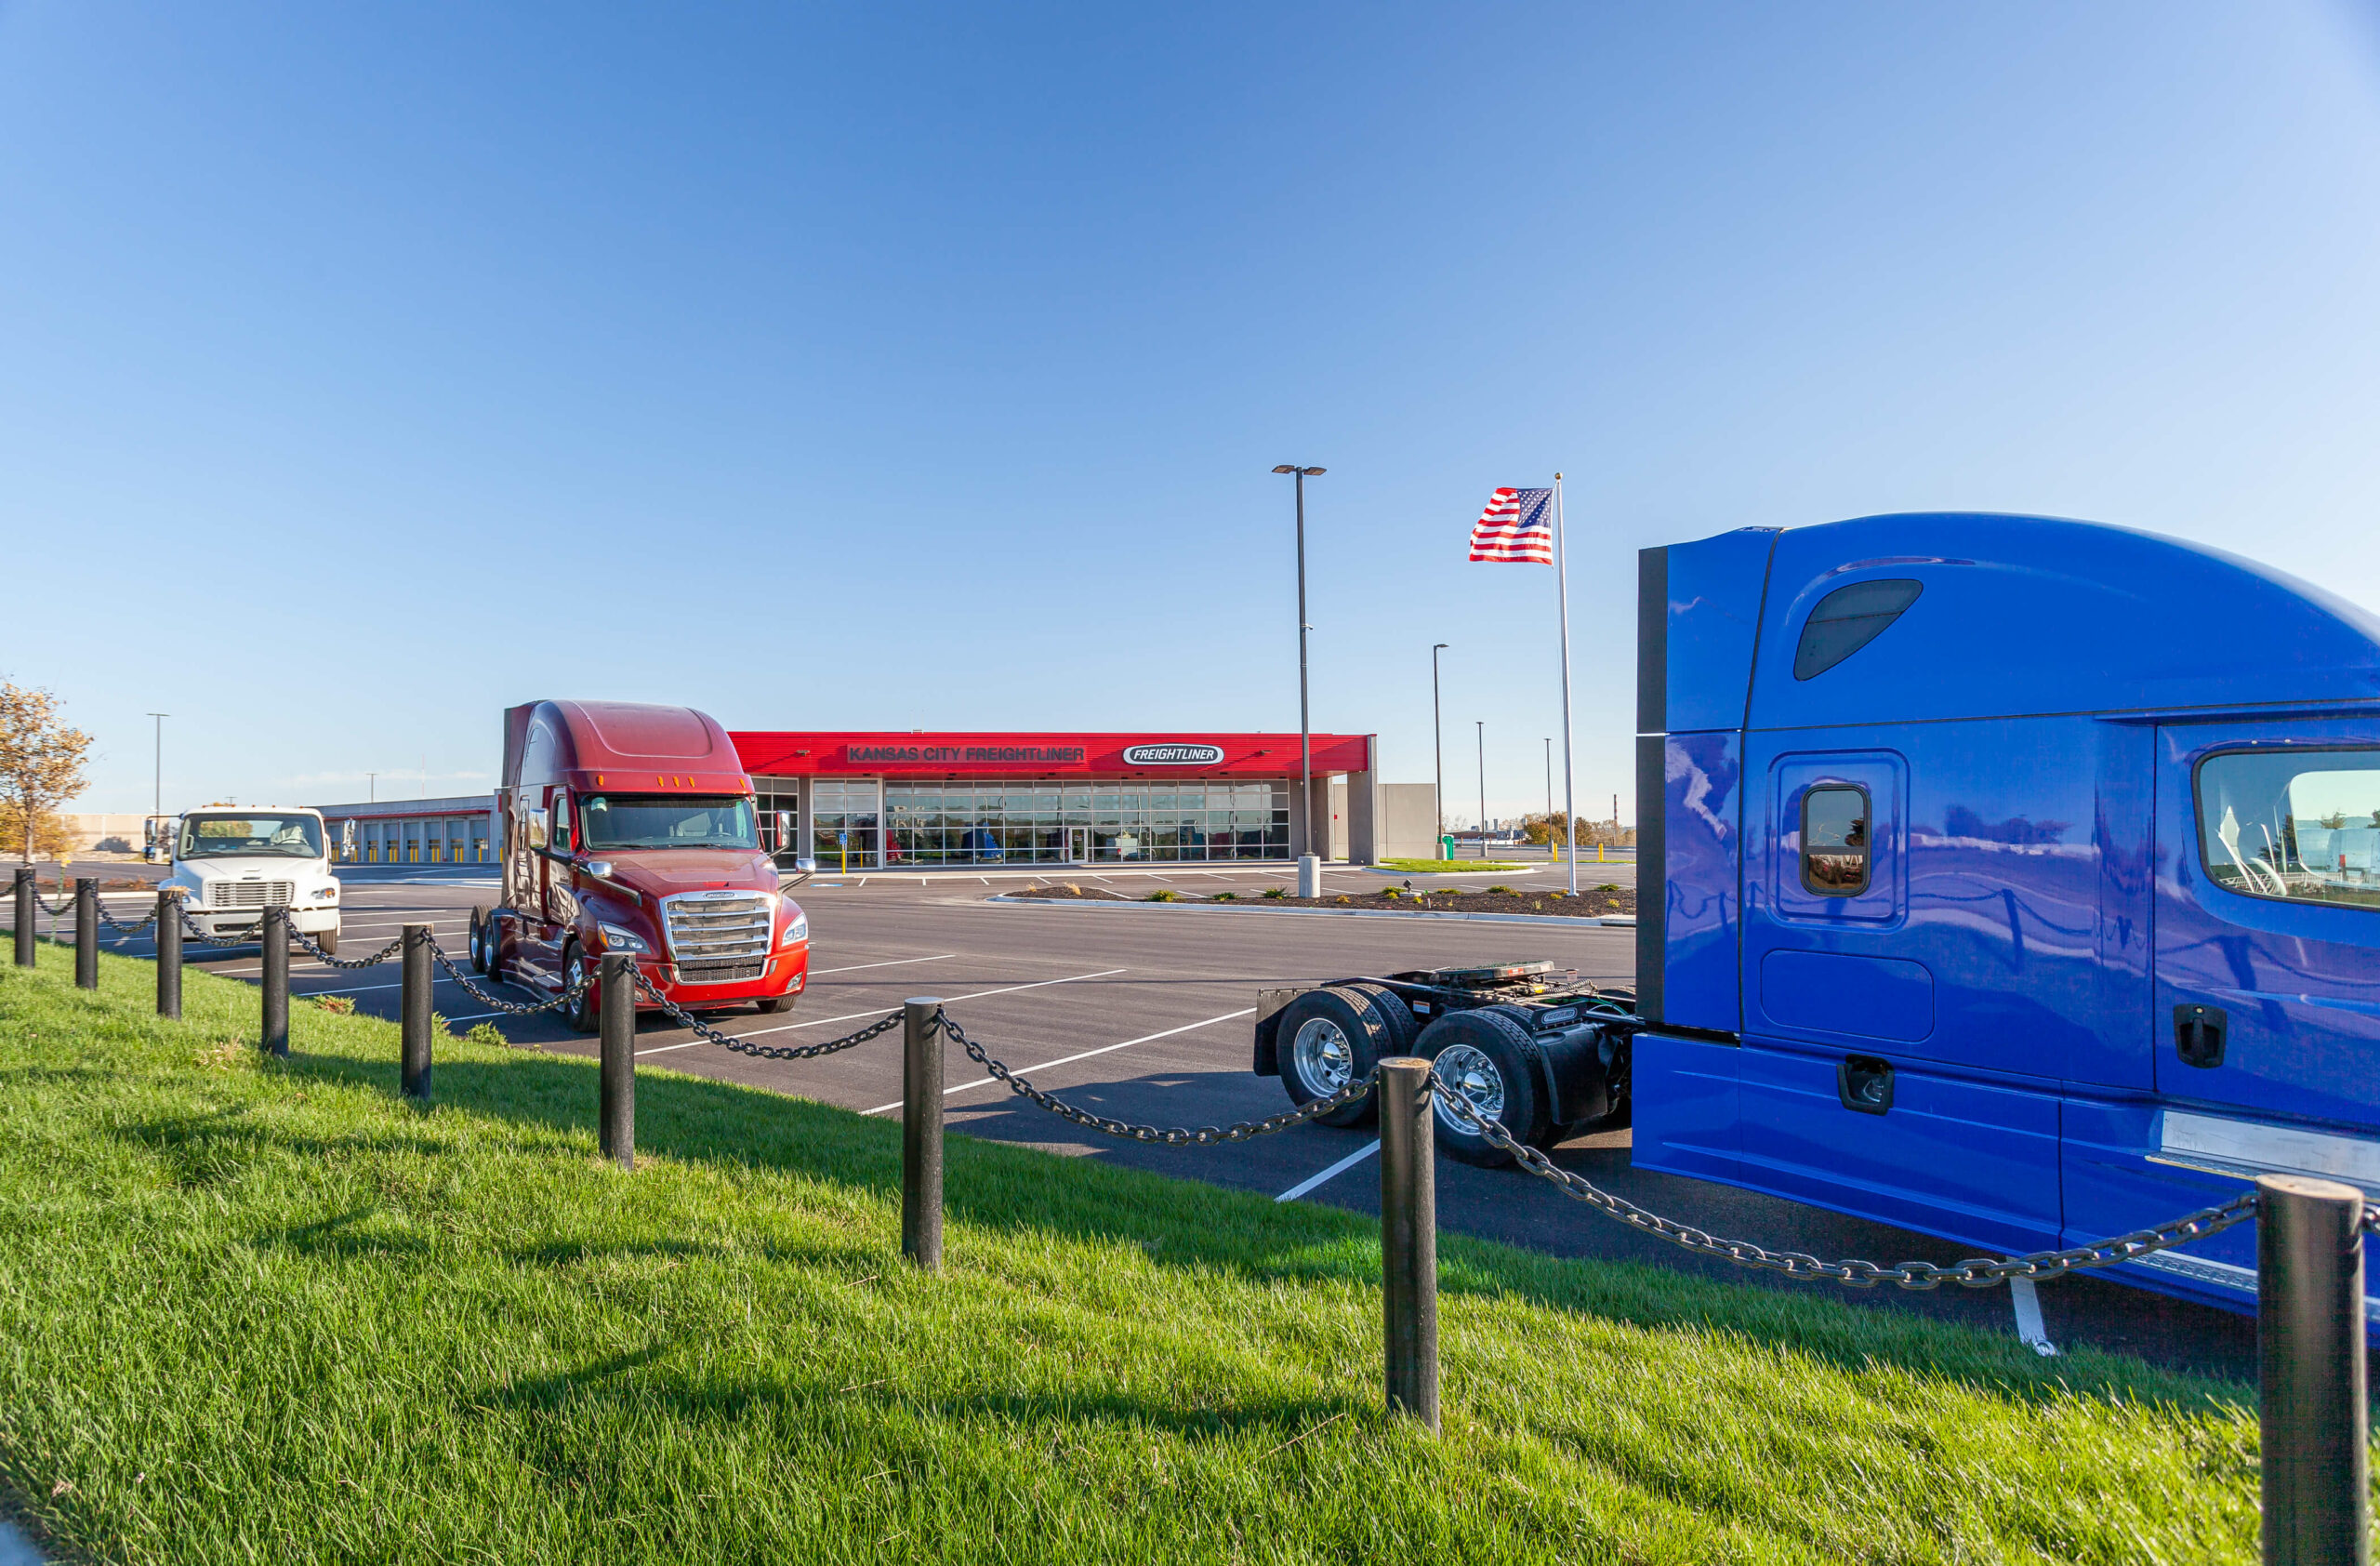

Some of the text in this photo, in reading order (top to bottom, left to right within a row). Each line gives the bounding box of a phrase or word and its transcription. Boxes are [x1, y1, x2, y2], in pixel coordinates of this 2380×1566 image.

[849, 747, 1084, 761] KANSAS CITY FREIGHTLINER
[1133, 748, 1215, 760] FREIGHTLINER
